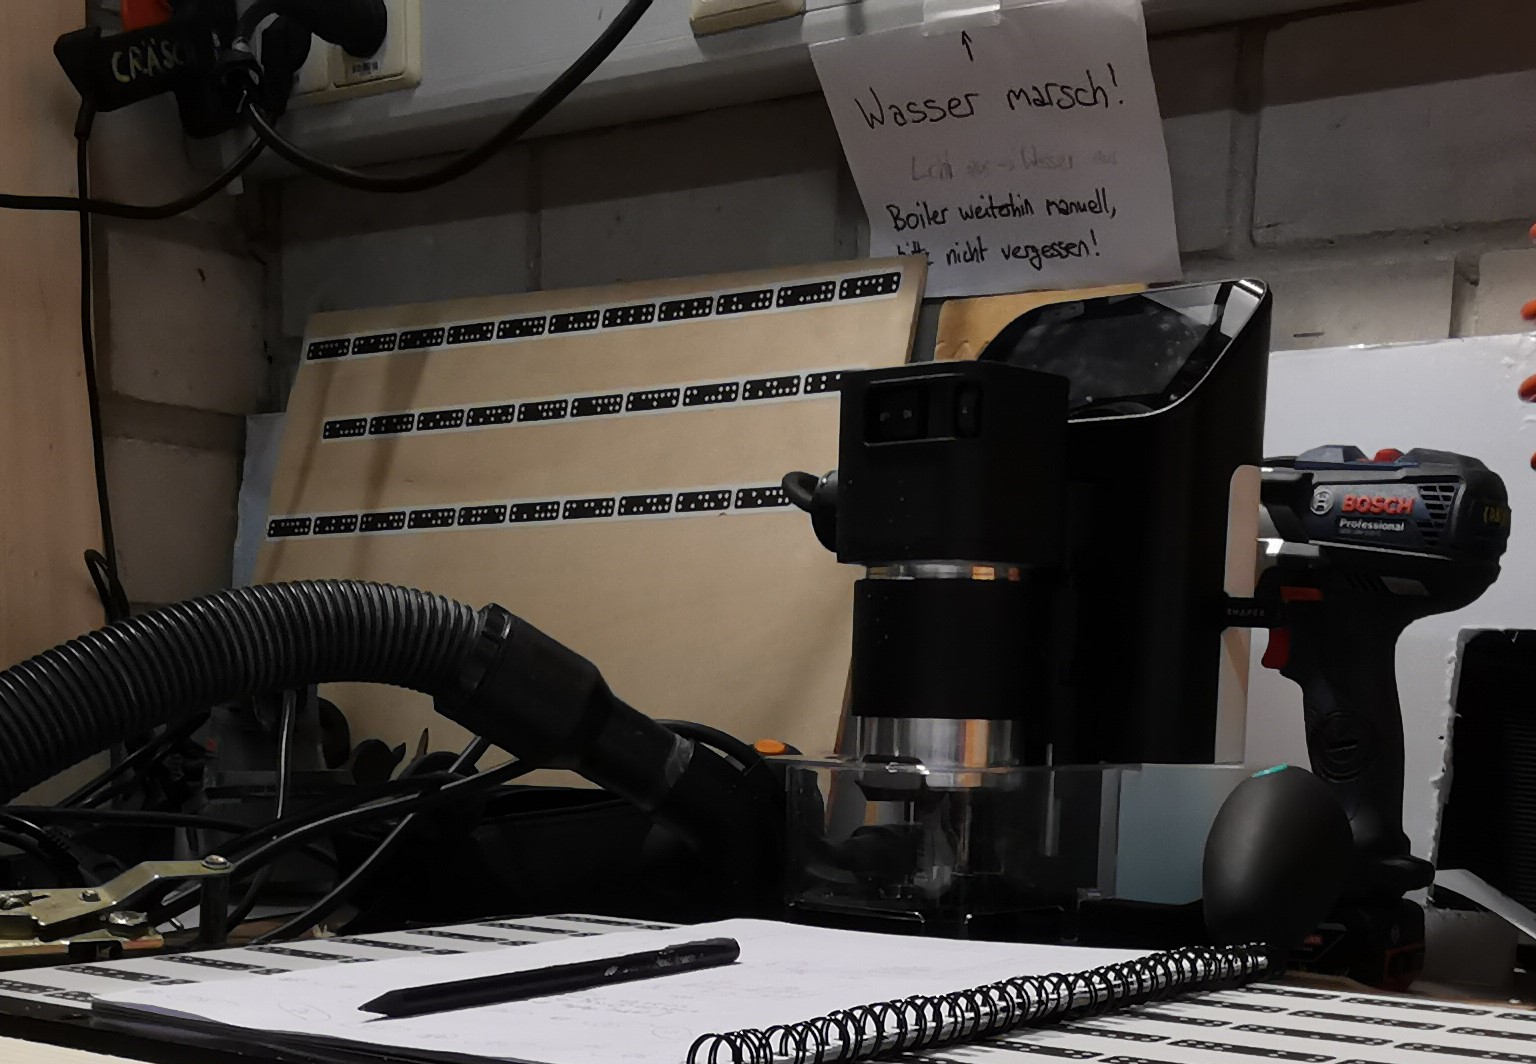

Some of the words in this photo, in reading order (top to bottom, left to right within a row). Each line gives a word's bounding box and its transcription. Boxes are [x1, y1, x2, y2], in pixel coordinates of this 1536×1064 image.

[854, 86, 979, 130] Wasser
[1006, 62, 1124, 111] marsch!
[885, 201, 949, 232] Boiler
[958, 192, 1035, 222] weiterhin
[1046, 187, 1117, 219] manuell,
[946, 235, 989, 266] nicht
[1000, 228, 1101, 271] vergessen!
[1338, 516, 1406, 533] Professional
[1341, 493, 1416, 516] BOSCH
